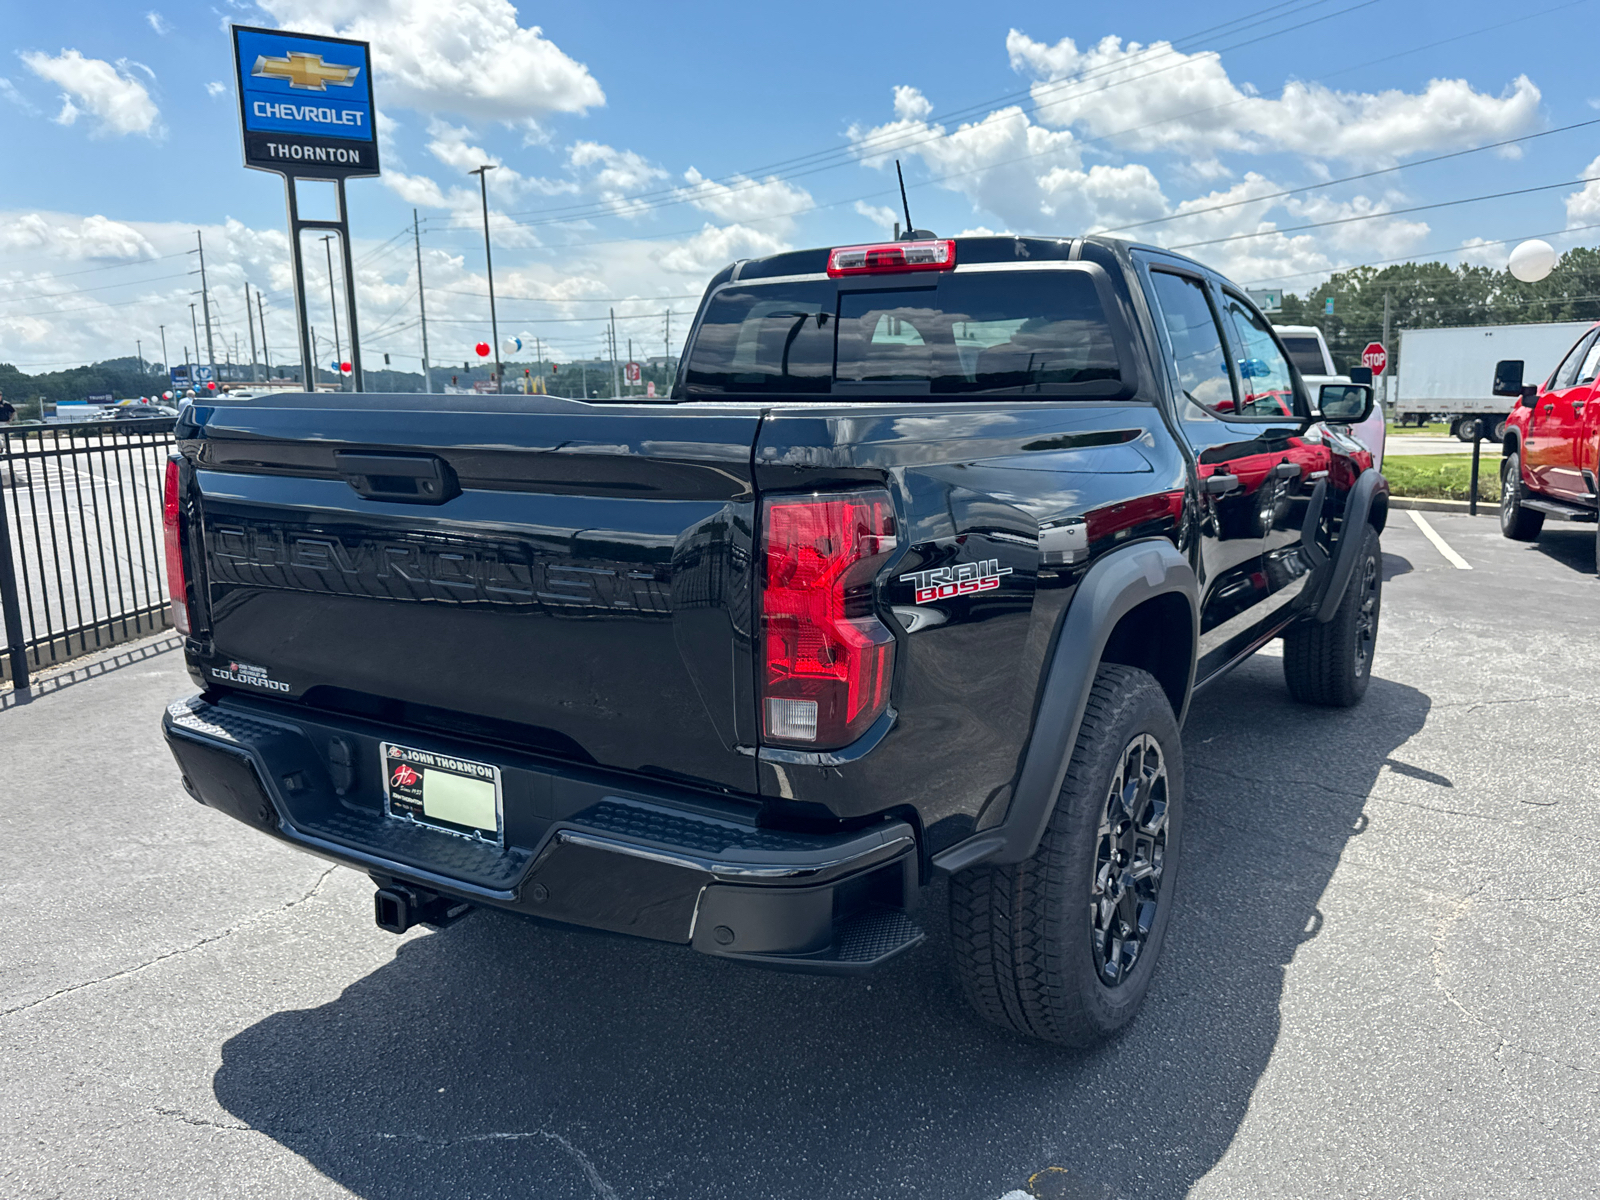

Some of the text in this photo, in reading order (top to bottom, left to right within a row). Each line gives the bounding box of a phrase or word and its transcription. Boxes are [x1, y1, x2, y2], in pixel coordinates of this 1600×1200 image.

[253, 101, 364, 126] CHEVROLET
[267, 143, 360, 163] THORNTON
[1363, 353, 1385, 367] STOP
[211, 523, 657, 606] CHEVROLET
[899, 558, 1013, 588] TRAIL
[915, 575, 1000, 604] BOSS
[211, 667, 290, 692] COLORADO
[407, 750, 435, 765] JOHN
[436, 756, 493, 778] THORNTON
